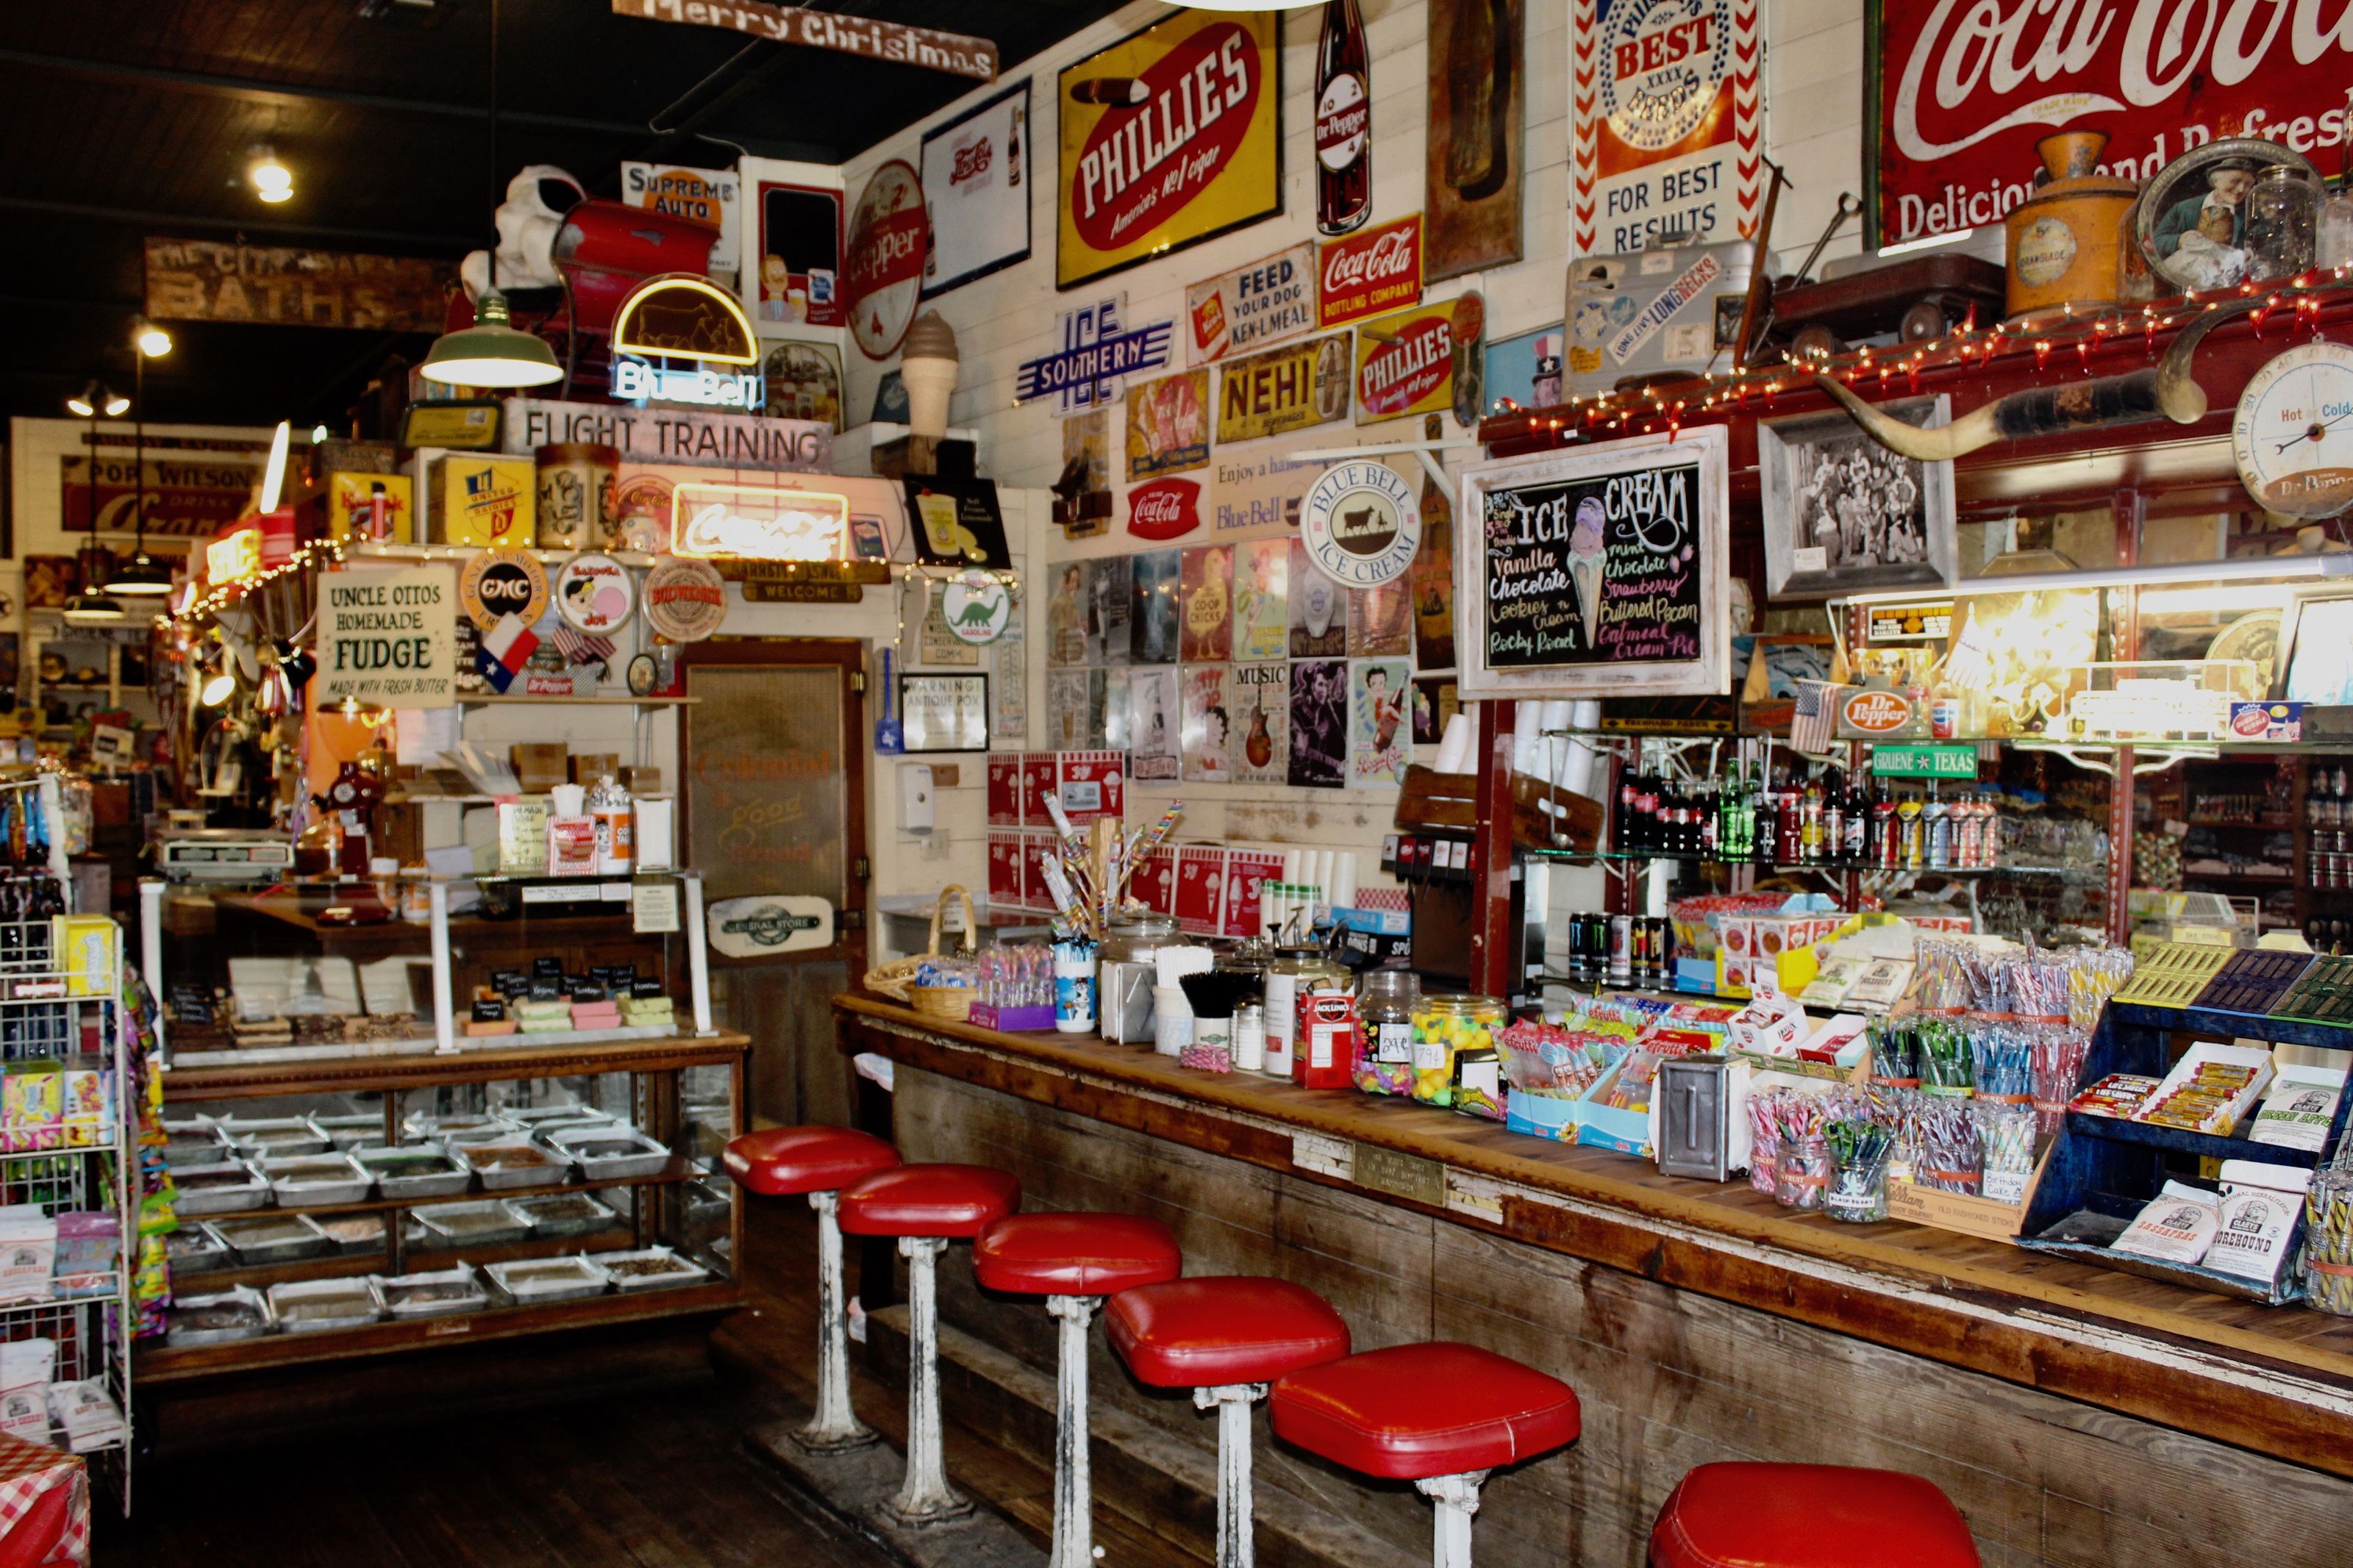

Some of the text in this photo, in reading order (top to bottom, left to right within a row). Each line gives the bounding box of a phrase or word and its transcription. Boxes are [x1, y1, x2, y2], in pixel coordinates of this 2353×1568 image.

[643, 0, 991, 79] Merry Christmas
[1614, 12, 1716, 82] BEST
[1350, 82, 1358, 96] 2
[1646, 65, 1684, 90] XXXX
[1627, 69, 1701, 123] FEEDS
[1081, 30, 1249, 221] PHILLIES
[1316, 108, 1367, 142] Dr Pepper
[629, 168, 735, 202] SUPREME
[1110, 145, 1221, 240] America's cigar
[1608, 160, 1722, 217] FOR BEST
[654, 196, 709, 218] AUTO
[1325, 226, 1415, 293] Coca-Cola
[1239, 259, 1293, 298] FEED
[148, 271, 388, 329] BATHS
[1233, 283, 1302, 318] YOUR DOG
[1324, 280, 1415, 318] BOTTLING COMPANY
[1268, 303, 1309, 331] MEAL
[1040, 334, 1145, 390] SOUTHERN
[1363, 322, 1452, 398] PHILLIES
[1227, 359, 1310, 422] NEHI
[2281, 401, 2351, 423] Hot Cold
[526, 410, 821, 465] FLIGHT TRAINING
[1218, 464, 1265, 485] Enjoy a
[1313, 466, 1407, 512] BLUE BELL
[1135, 491, 1182, 524] Coca-Cola
[1217, 496, 1280, 531] Blue Bell
[1516, 493, 1569, 546] ICE
[1604, 468, 1689, 545] CREAM
[1317, 533, 1415, 581] ICE CREAM
[1494, 548, 1558, 578] Vanilla
[330, 582, 442, 609] UNCLE OTTO'S
[480, 579, 530, 601] GMC
[1490, 568, 1571, 601] Chocolate
[1189, 612, 1221, 624] CHICKS
[1194, 599, 1221, 612] CO-OP
[1599, 594, 1698, 625] Buttered Pecan
[335, 611, 424, 631] HOMEMADE
[960, 628, 992, 636] GASOLINE
[1532, 612, 1581, 631] Cream
[334, 637, 434, 673] FUDGE
[1490, 627, 1577, 658] Rocky Road
[1667, 634, 1697, 656] Pie
[327, 677, 449, 695] MADE WITH FRESH BUTTER
[907, 679, 980, 692] WARNING!
[1236, 666, 1287, 686] MUSIC
[907, 695, 979, 707] ANTIQUE POX
[1852, 703, 1907, 727] Pepper
[1870, 695, 1895, 710] Dr
[1874, 751, 1975, 772] GRUENE TEXAS
[776, 918, 809, 929] STORE
[1313, 1003, 1331, 1014] JACK
[2258, 1108, 2299, 1123] GREEN
[1985, 1172, 2022, 1187] Birthday
[1987, 1184, 2010, 1198] Cake
[1952, 1207, 1990, 1223] FASHIONED
[1991, 1217, 2015, 1228] STICKS
[2137, 1220, 2198, 1242] SASSAFRAS
